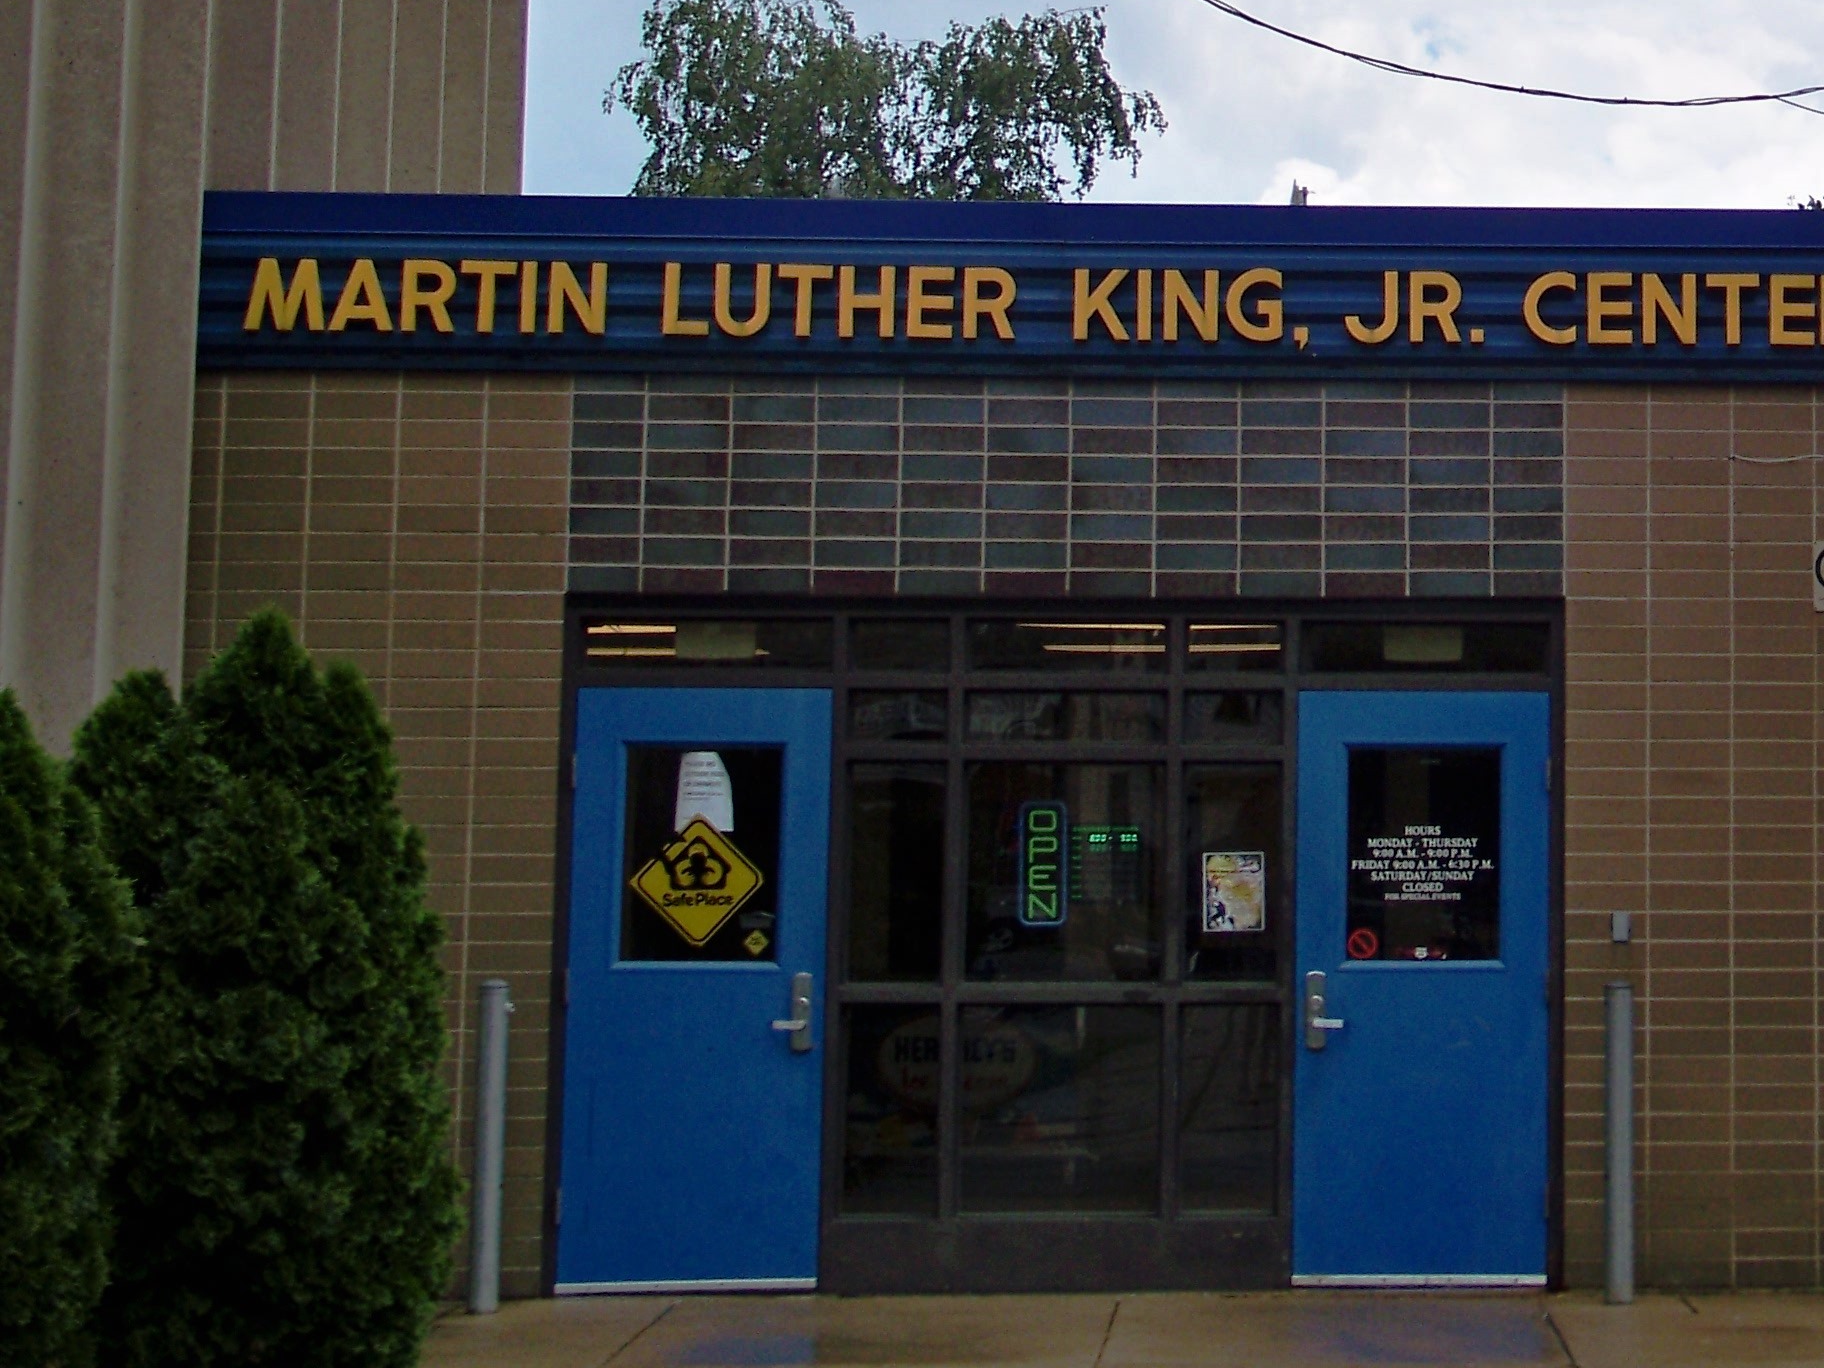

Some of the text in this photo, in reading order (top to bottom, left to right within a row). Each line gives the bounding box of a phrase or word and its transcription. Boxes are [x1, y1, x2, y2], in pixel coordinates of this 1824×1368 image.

[244, 257, 607, 335] MARTIN
[661, 262, 1016, 339] LUTHER
[1072, 267, 1309, 349] KING,
[1344, 270, 1484, 344] JR.
[1404, 825, 1442, 836] HOURS
[1367, 837, 1412, 848] MONDAY
[1421, 837, 1478, 848] THURSDAY
[1395, 848, 1419, 858] A.M.
[1450, 848, 1473, 858] P.M.
[1028, 809, 1058, 920] OPEN
[1351, 859, 1391, 869] FRIDAY
[1416, 859, 1440, 869] A.M.
[1471, 859, 1494, 869] P.M.
[1371, 870, 1475, 881] SATURDAY/SUNDAY
[1402, 881, 1444, 892] CLOSED
[662, 892, 734, 906] Safe Place
